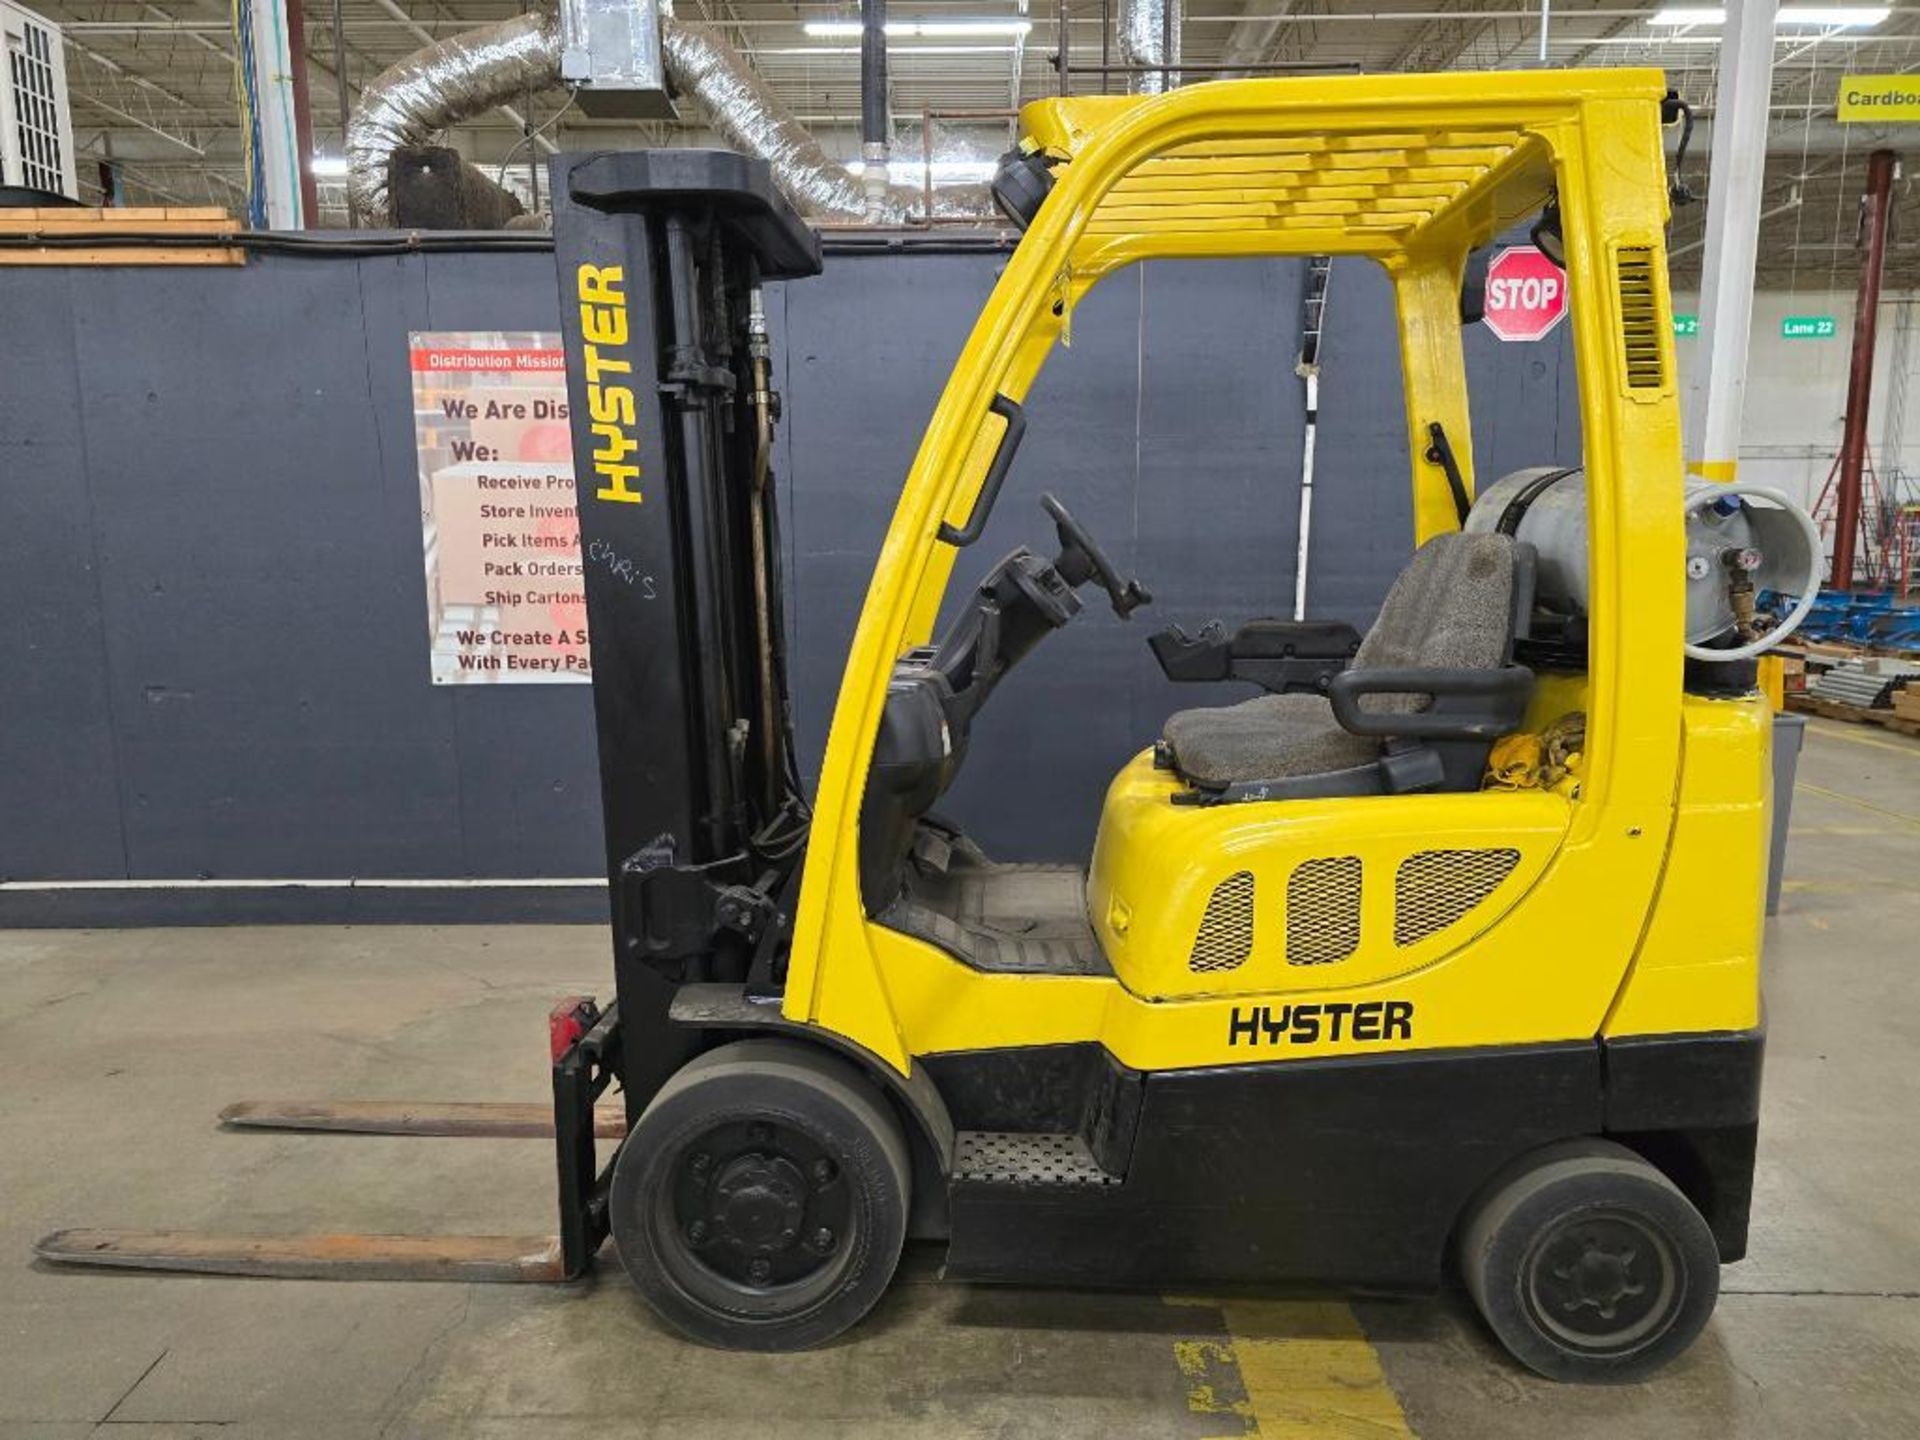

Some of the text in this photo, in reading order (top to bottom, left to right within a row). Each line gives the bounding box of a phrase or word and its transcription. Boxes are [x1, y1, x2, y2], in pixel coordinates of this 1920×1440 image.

[1847, 89, 1920, 106] Cardbo
[1489, 277, 1559, 310] STOP
[1784, 321, 1834, 335] Lane 22
[429, 354, 512, 368] Distribution
[577, 263, 643, 503] HYSTER
[443, 399, 569, 419] We Are Dis
[451, 441, 499, 461] We:
[477, 475, 575, 489] Receive Pro
[480, 504, 526, 518] Store
[482, 533, 518, 547] Pick
[522, 533, 569, 548] Items
[484, 562, 584, 576] Pack Orders
[485, 591, 521, 607] Ship
[456, 630, 587, 645] We Create A S
[458, 655, 588, 672] With Every Pa
[1228, 1001, 1414, 1046] HYSTER
